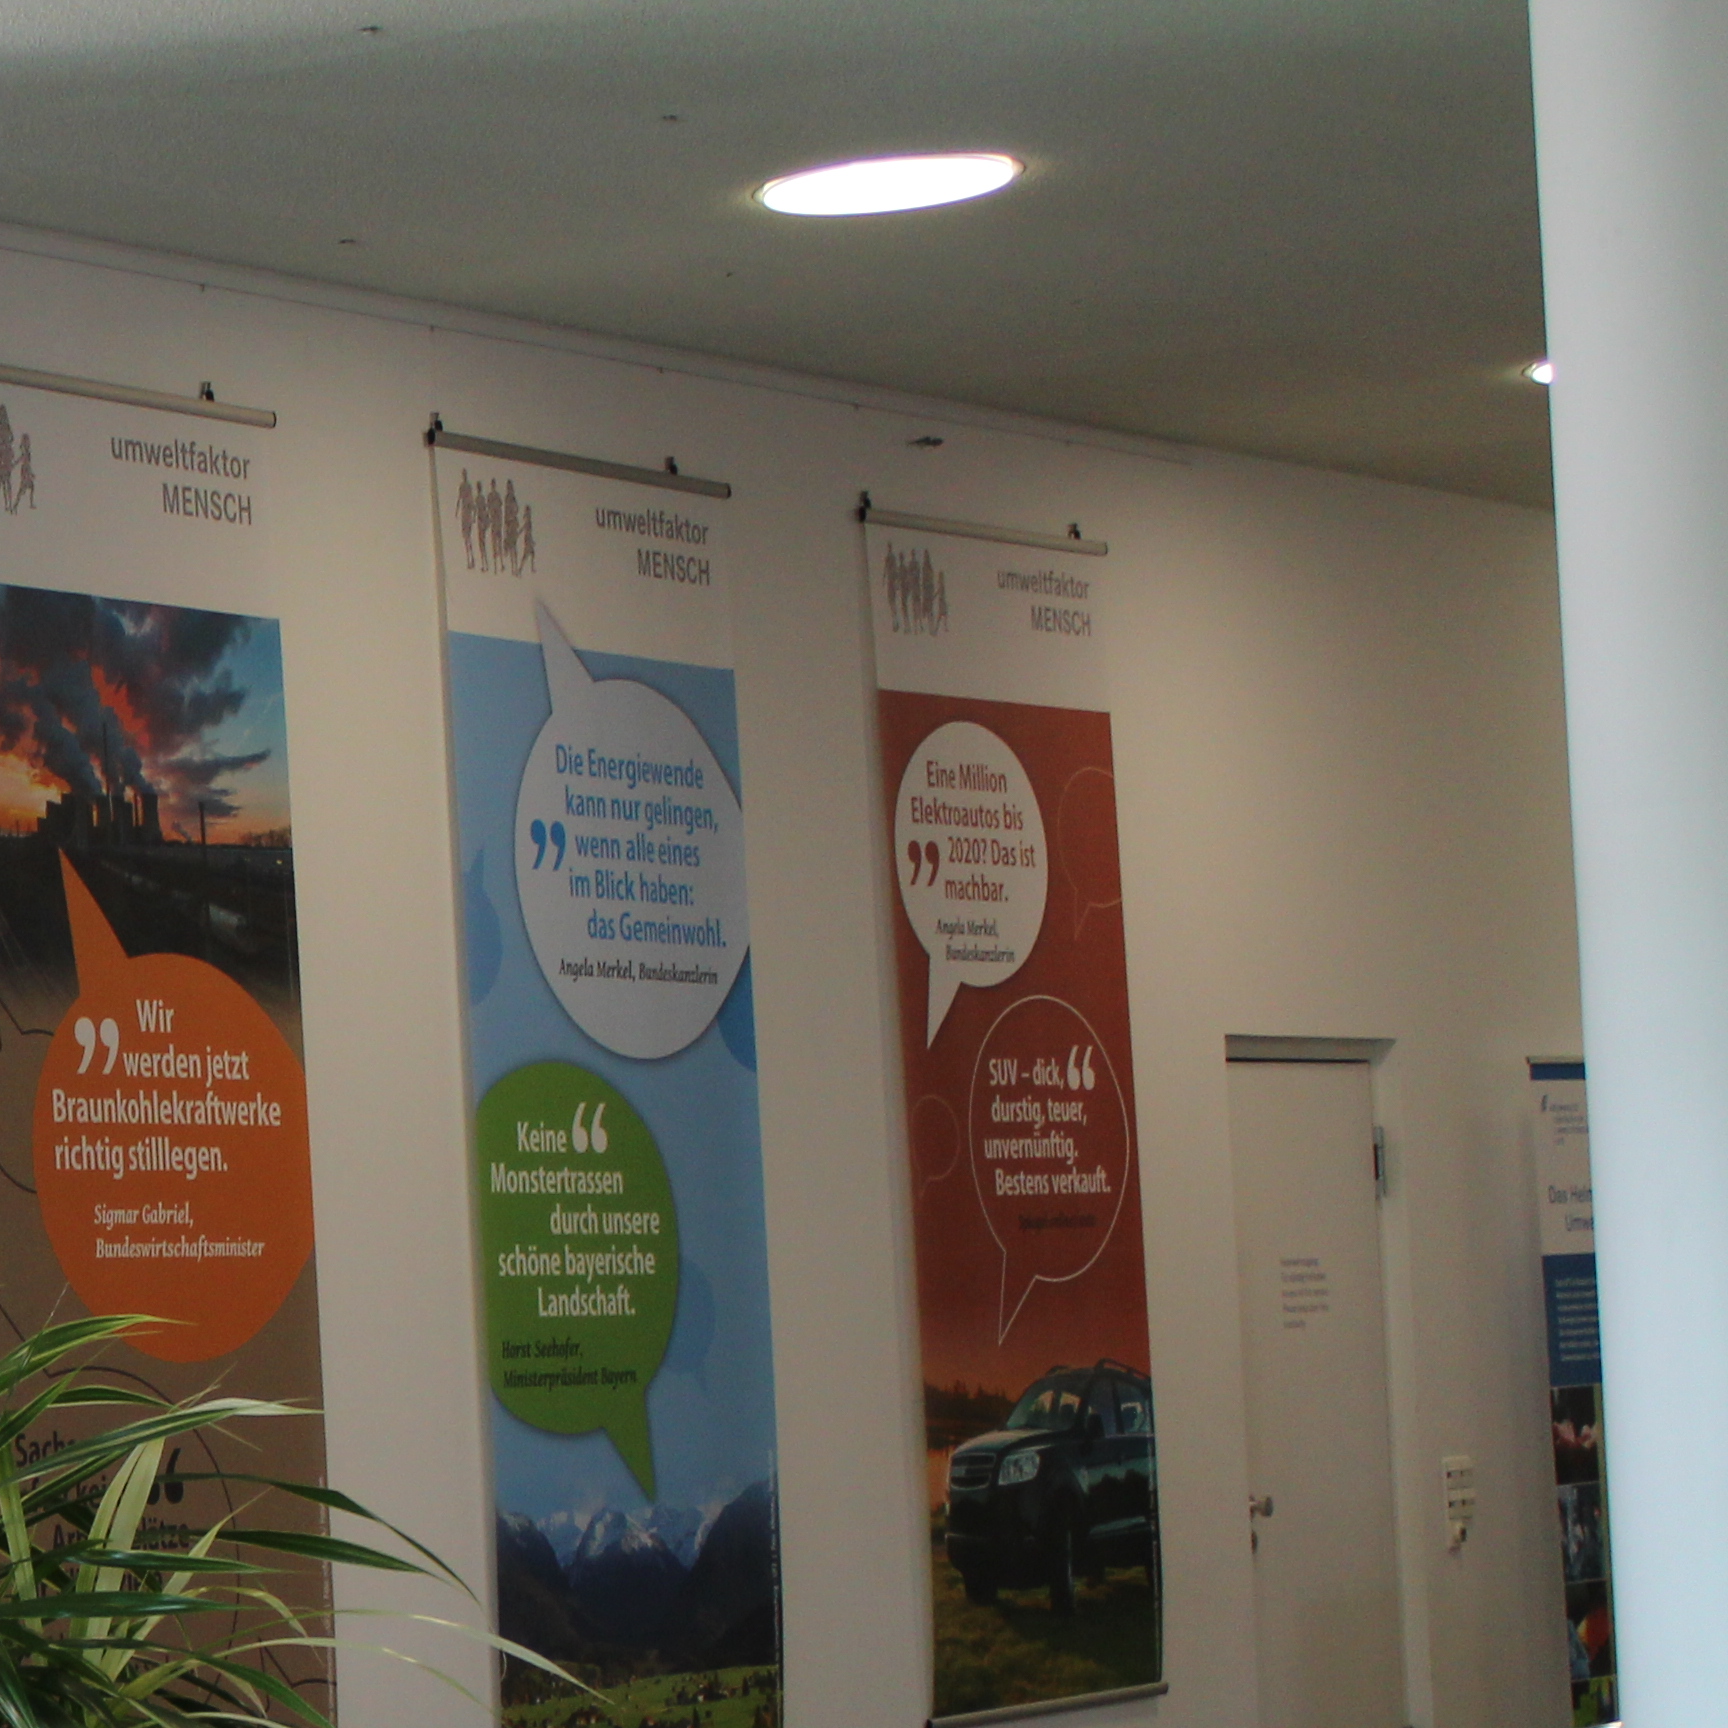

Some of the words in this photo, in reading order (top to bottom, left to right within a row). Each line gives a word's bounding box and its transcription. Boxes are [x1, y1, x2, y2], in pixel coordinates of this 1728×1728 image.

[110, 434, 251, 480] umweltfaktor
[162, 483, 253, 526] MENSCH
[595, 505, 708, 545] umweltfaktor
[637, 548, 711, 586] MENSCH
[997, 568, 1090, 599] umweltfaktor
[1031, 605, 1092, 637] MENSCH
[555, 743, 584, 776] Die
[588, 748, 704, 790] Energiewende
[926, 759, 957, 791] Eine
[959, 762, 1008, 794] Million
[565, 785, 607, 819] kann
[611, 796, 640, 822] nur
[644, 794, 718, 836] gelingen,
[911, 796, 1000, 830] Elektroautos
[1003, 802, 1024, 831] bis
[574, 834, 621, 860] wenn
[626, 833, 655, 865] alle
[658, 838, 700, 868] eines
[948, 835, 987, 865] 2020?
[991, 841, 1017, 867] Das
[1019, 841, 1036, 869] ist
[569, 868, 591, 898] im
[595, 870, 635, 902] Blick
[639, 873, 695, 906] haben:
[945, 873, 1009, 903] machbar.
[587, 908, 616, 940] das
[619, 912, 727, 948] Gemeinwohl.
[558, 957, 594, 983] Angela
[596, 959, 636, 983] Merkel,
[638, 961, 718, 985] Bundeskanzlerin
[135, 999, 175, 1033] Wir
[123, 1044, 202, 1080] werden
[205, 1046, 250, 1087] jetzt
[989, 1058, 1017, 1086] SUV
[1032, 1059, 1065, 1090] dick,
[52, 1089, 282, 1127] Braunkohlekraftwerke
[992, 1095, 1045, 1129] durstig,
[1047, 1097, 1087, 1126] teuer,
[517, 1120, 568, 1154] Keine
[984, 1130, 1078, 1164] unvernünftig.
[55, 1135, 124, 1180] richtig
[127, 1136, 229, 1179] stilllegen.
[490, 1162, 624, 1196] Monstertrassen
[995, 1168, 1050, 1197] Bestens
[1051, 1165, 1111, 1196] verkauft.
[94, 1203, 139, 1230] Sigmar
[141, 1202, 194, 1229] Gabriel,
[549, 1203, 598, 1236] durch
[602, 1210, 660, 1236] unsere
[95, 1235, 266, 1263] Bundeswirtschaftsminister
[498, 1245, 561, 1277] schöne
[565, 1243, 656, 1284] bayerische
[537, 1284, 636, 1318] Landschaft.
